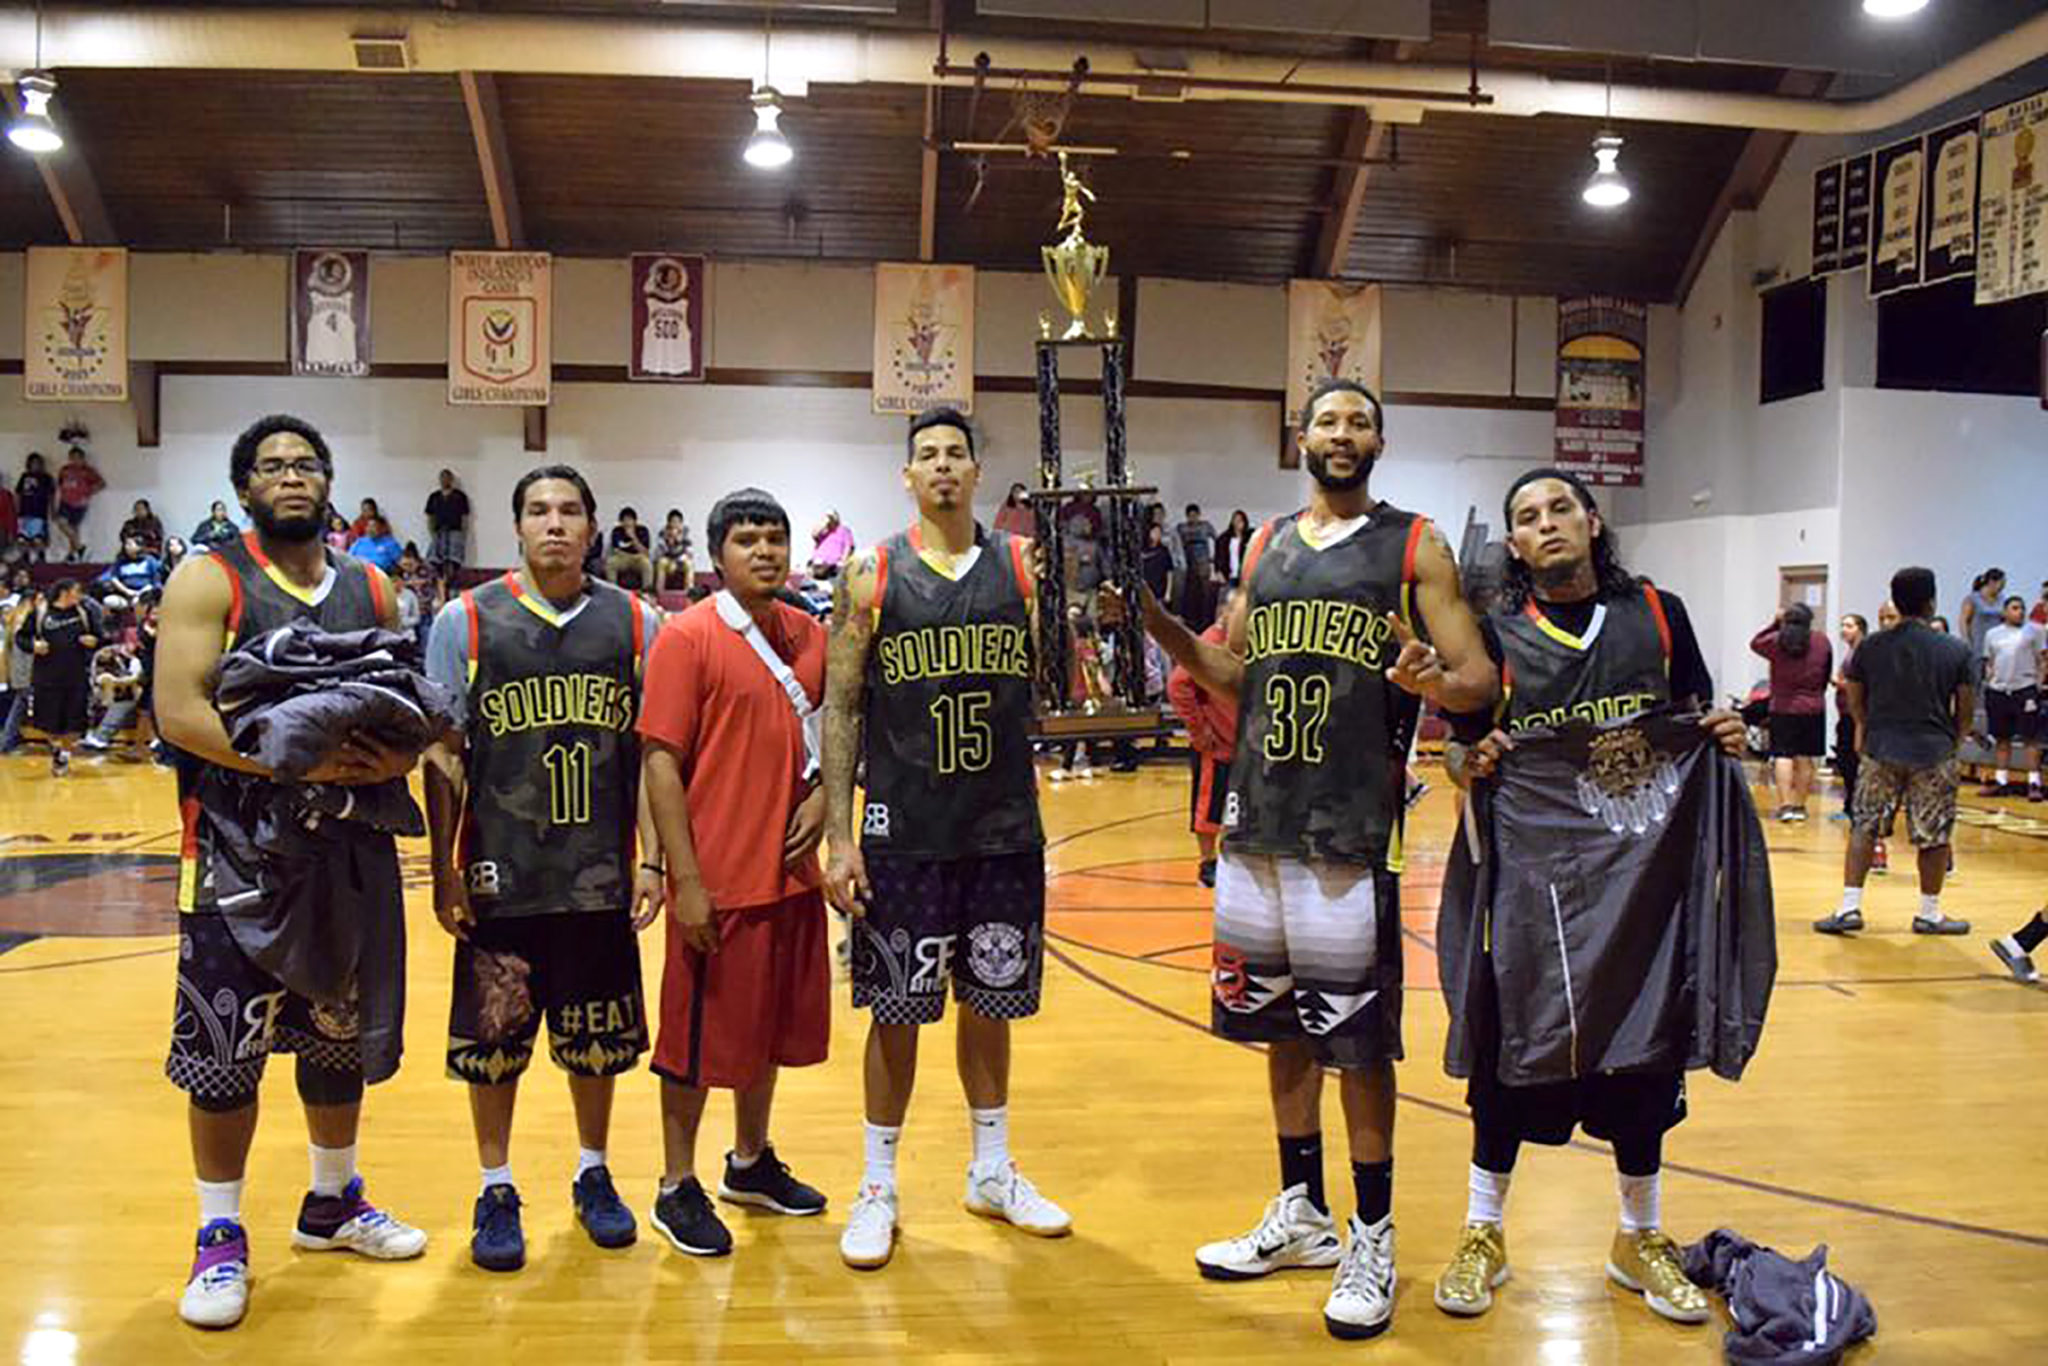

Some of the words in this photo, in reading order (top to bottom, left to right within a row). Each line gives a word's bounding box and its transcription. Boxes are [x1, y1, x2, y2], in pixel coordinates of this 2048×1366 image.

[480, 673, 634, 737] SOLDIERS
[930, 691, 992, 773] 15
[1264, 674, 1331, 763] 32
[543, 741, 590, 824] 11
